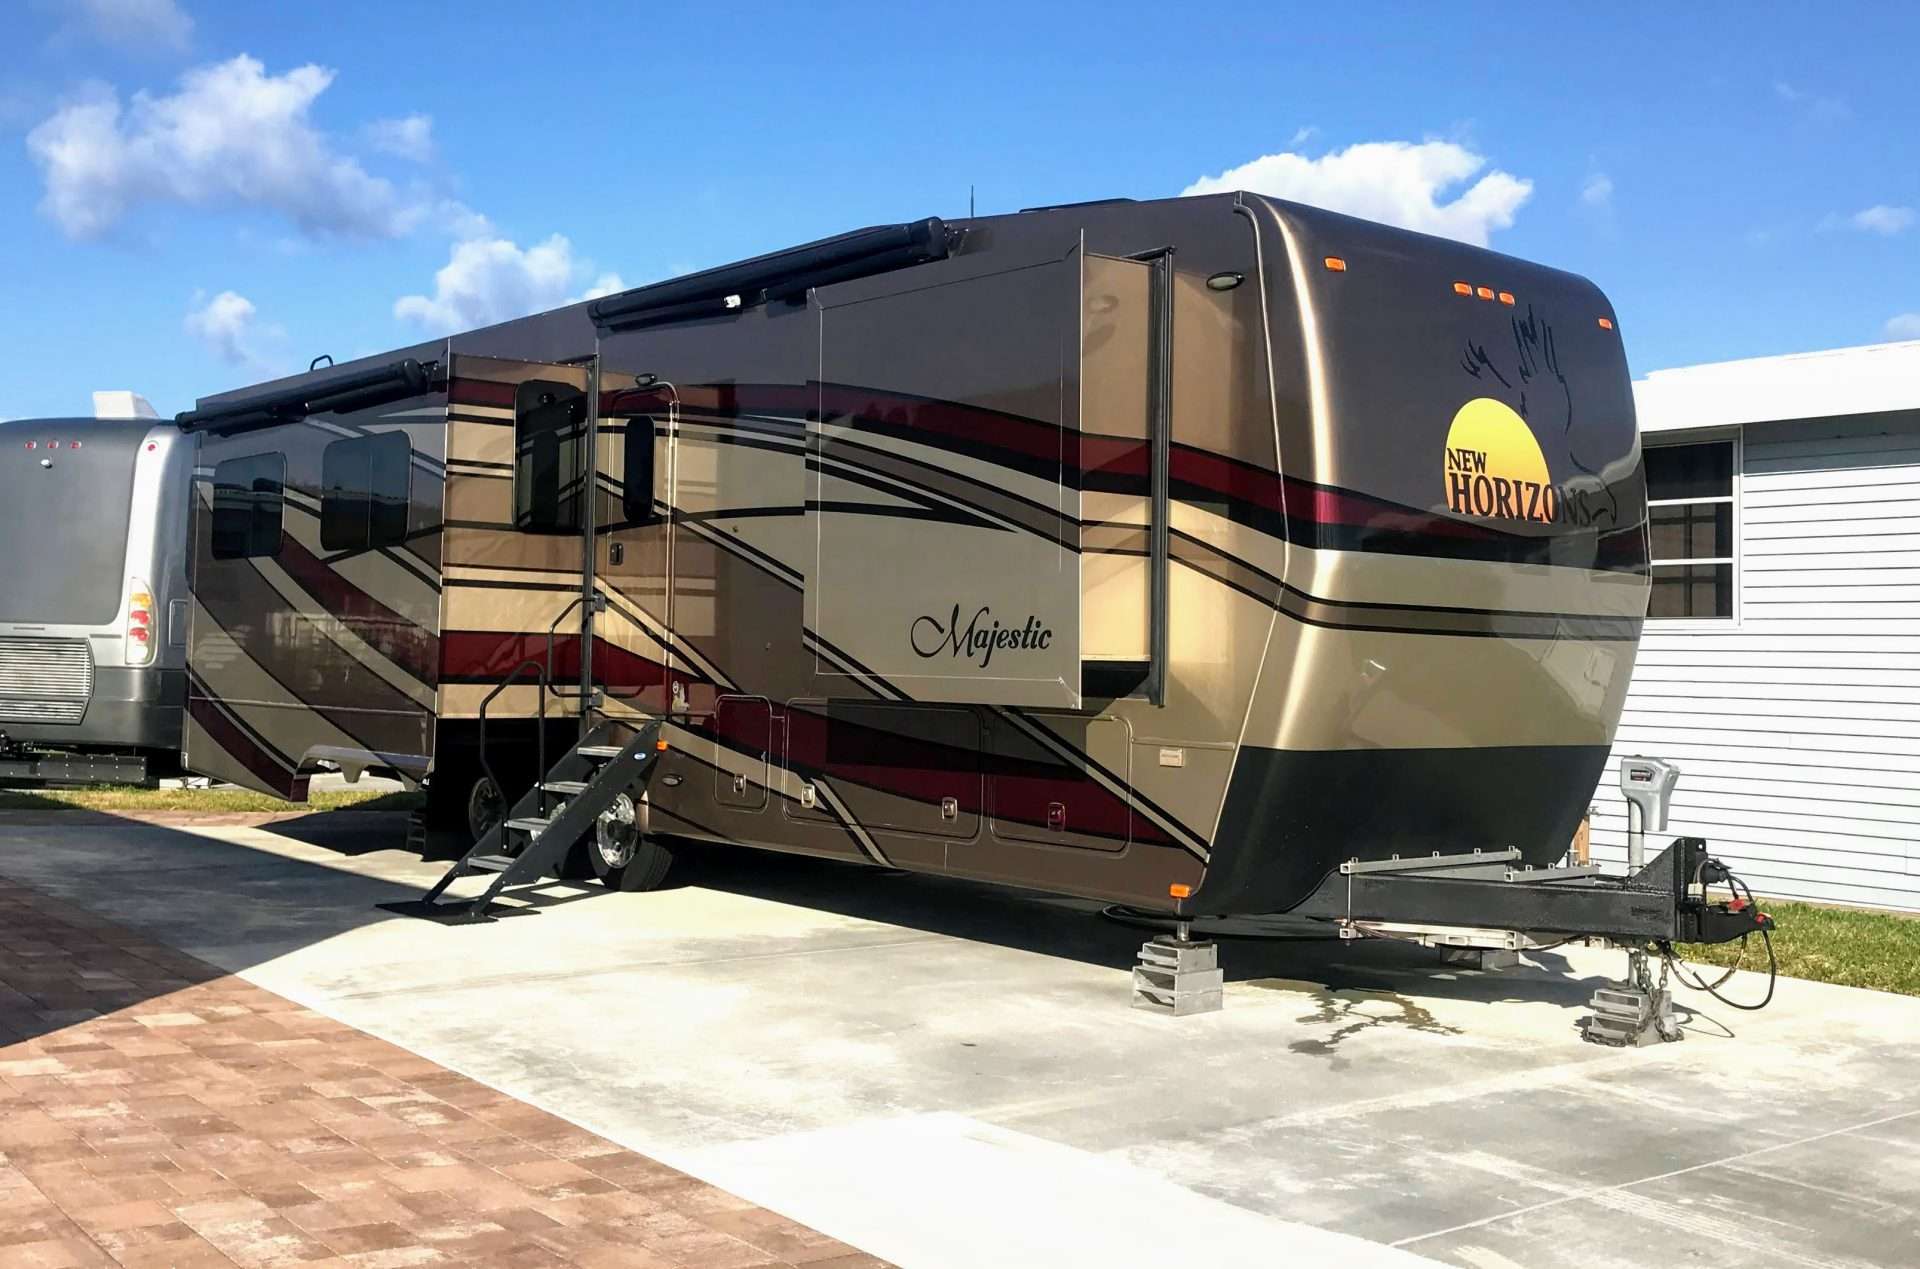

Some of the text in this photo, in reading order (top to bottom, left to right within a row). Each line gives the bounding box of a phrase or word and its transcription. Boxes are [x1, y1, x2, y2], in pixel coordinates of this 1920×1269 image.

[1447, 448, 1487, 473] NEW
[1449, 473, 1591, 527] HORIZONS
[910, 603, 1052, 668] Majestic
